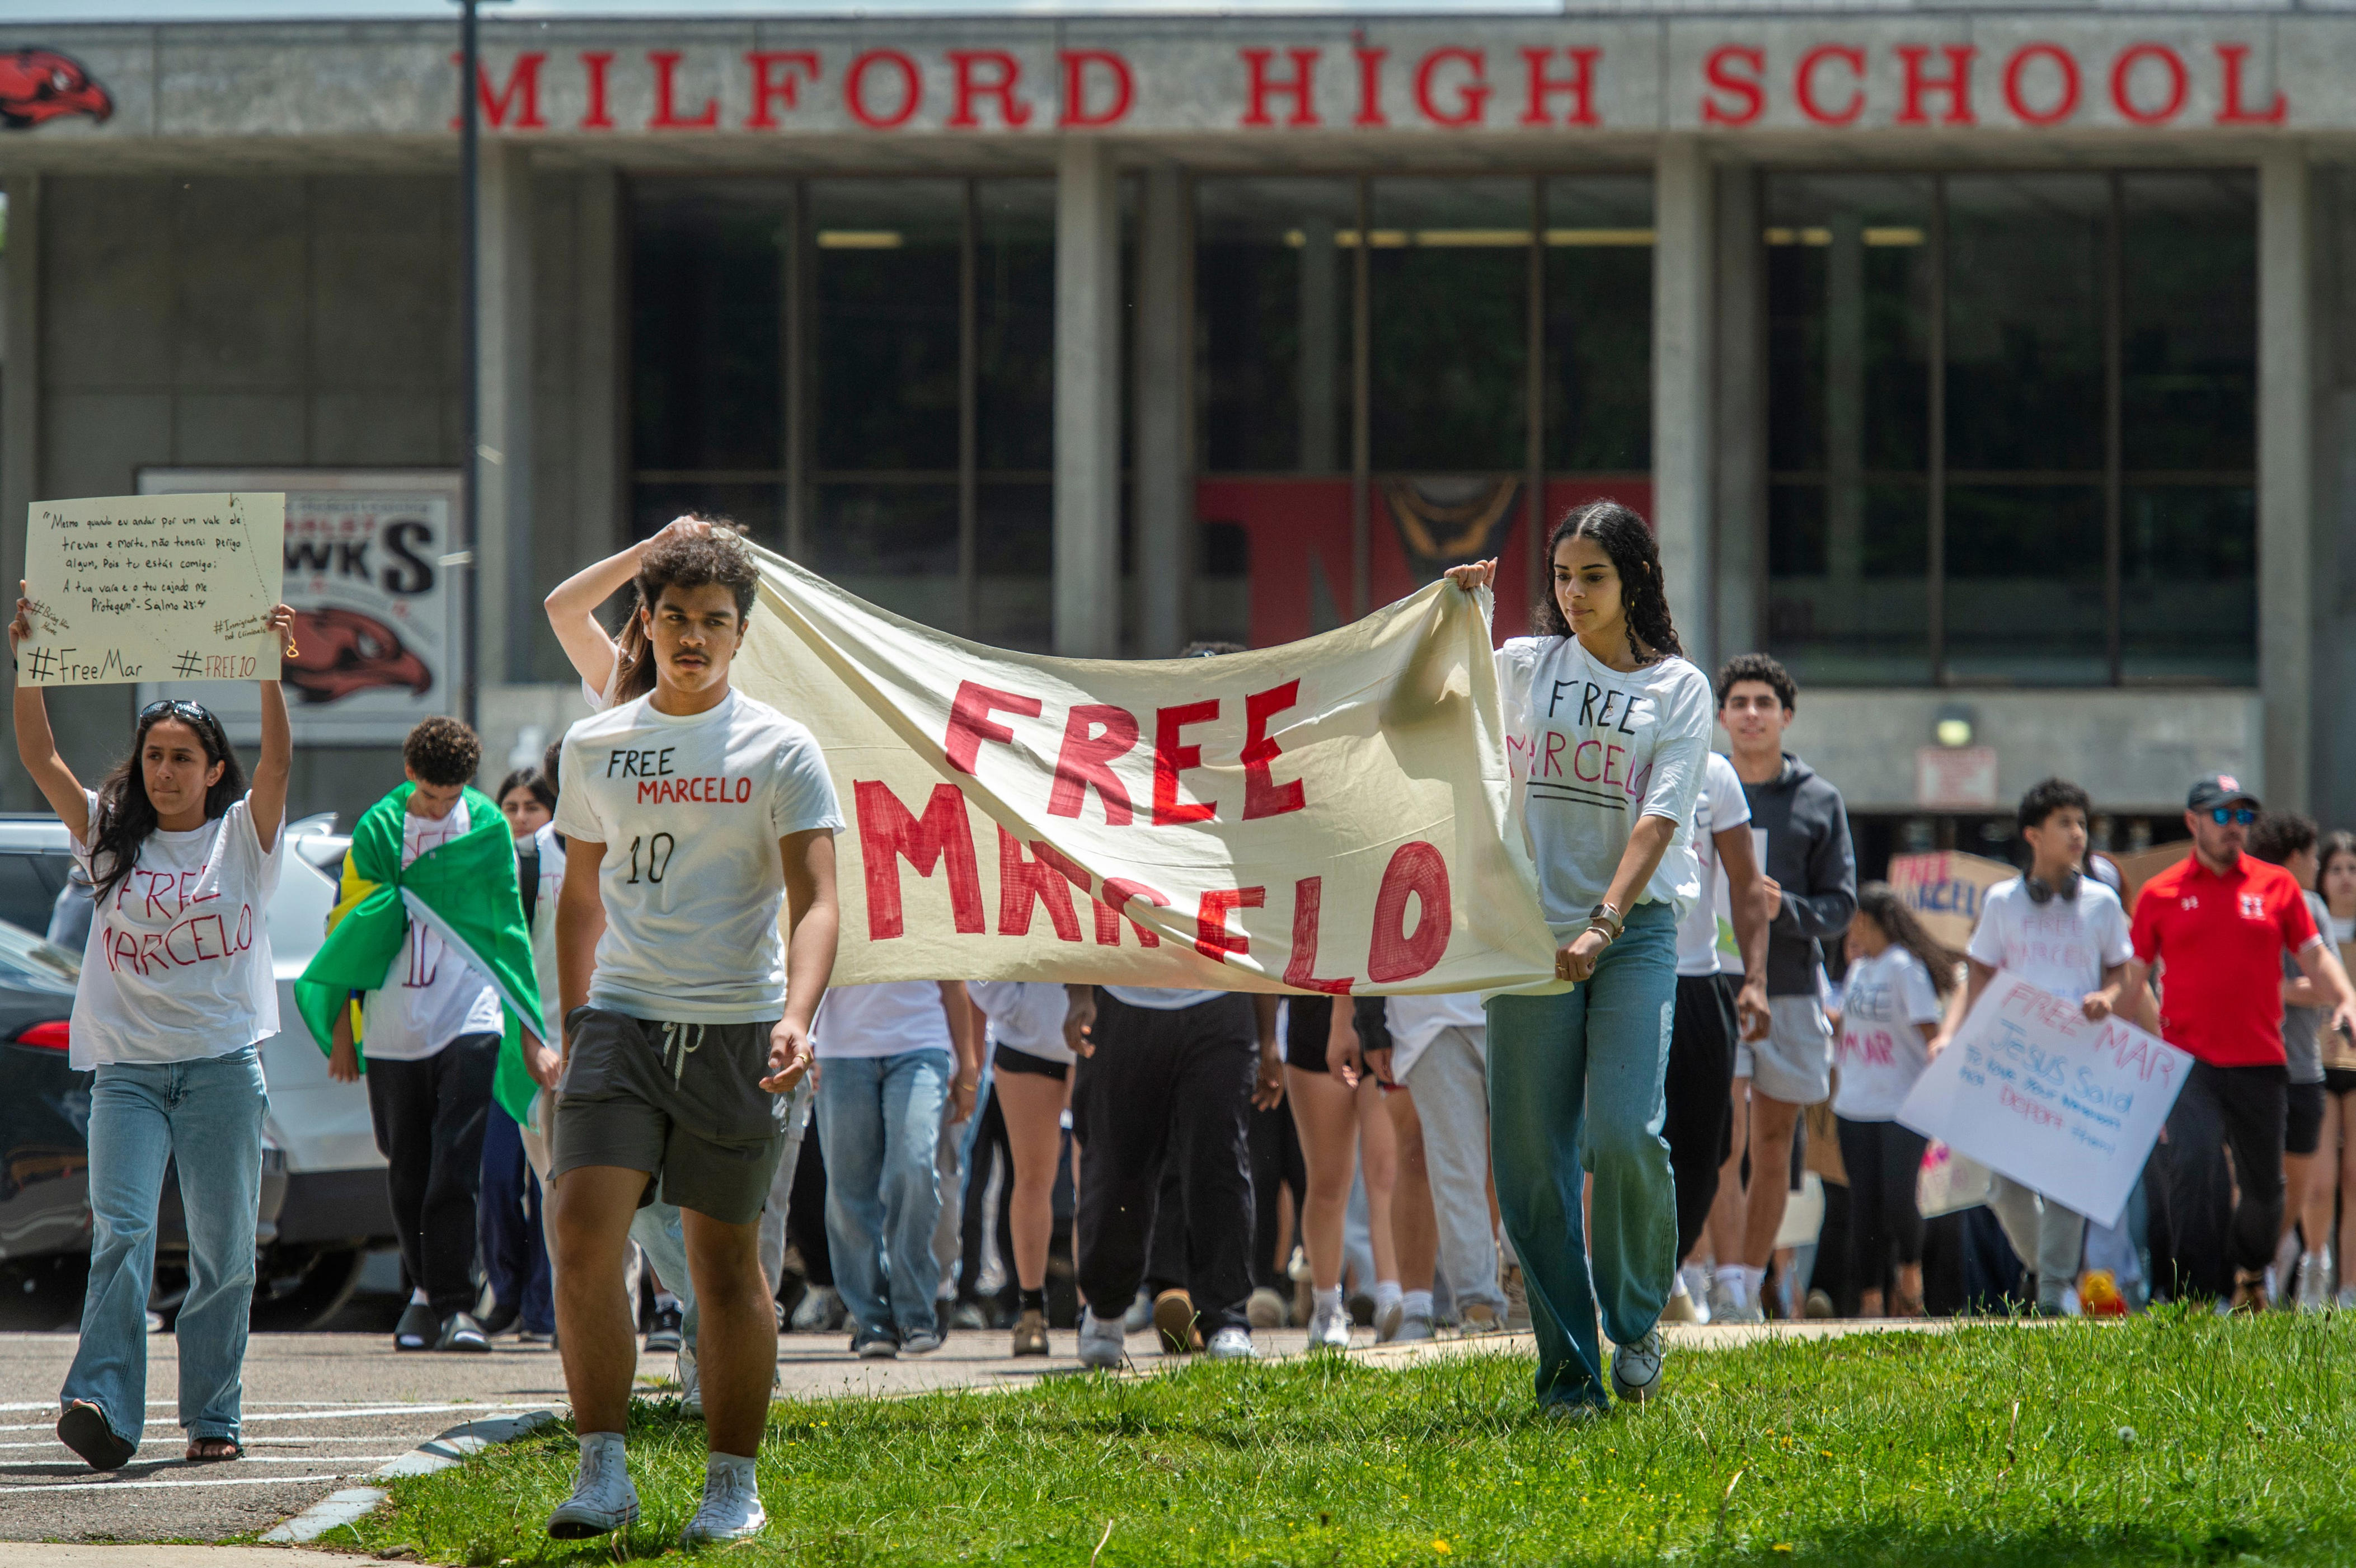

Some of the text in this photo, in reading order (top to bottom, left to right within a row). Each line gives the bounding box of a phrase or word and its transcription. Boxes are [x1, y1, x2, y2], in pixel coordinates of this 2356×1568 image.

[449, 43, 2288, 131] MILFORD HIGH SCHOOL
[87, 515, 112, 530] quando
[132, 516, 156, 525] andar
[161, 517, 176, 528] por
[229, 513, 241, 524] de
[62, 536, 98, 551] trevas
[152, 538, 169, 547] não
[173, 535, 205, 547] temerei
[65, 558, 98, 572] algum,
[126, 557, 139, 569] tu
[146, 557, 172, 569] estás
[62, 579, 69, 593] A
[75, 581, 93, 593] tua
[99, 584, 118, 593] vara
[142, 581, 157, 591] teu
[161, 578, 189, 594] cajado
[144, 598, 179, 611] Salmo
[183, 599, 206, 611] 23:4
[1548, 680, 1647, 735] FREE
[607, 747, 675, 778] FREE
[945, 678, 1306, 827] FREE
[637, 777, 752, 804] MARCELO
[626, 832, 675, 885] 10
[116, 864, 221, 919] FREE
[1847, 983, 1893, 1022] REE
[2001, 982, 2175, 1088] FREE MAR
